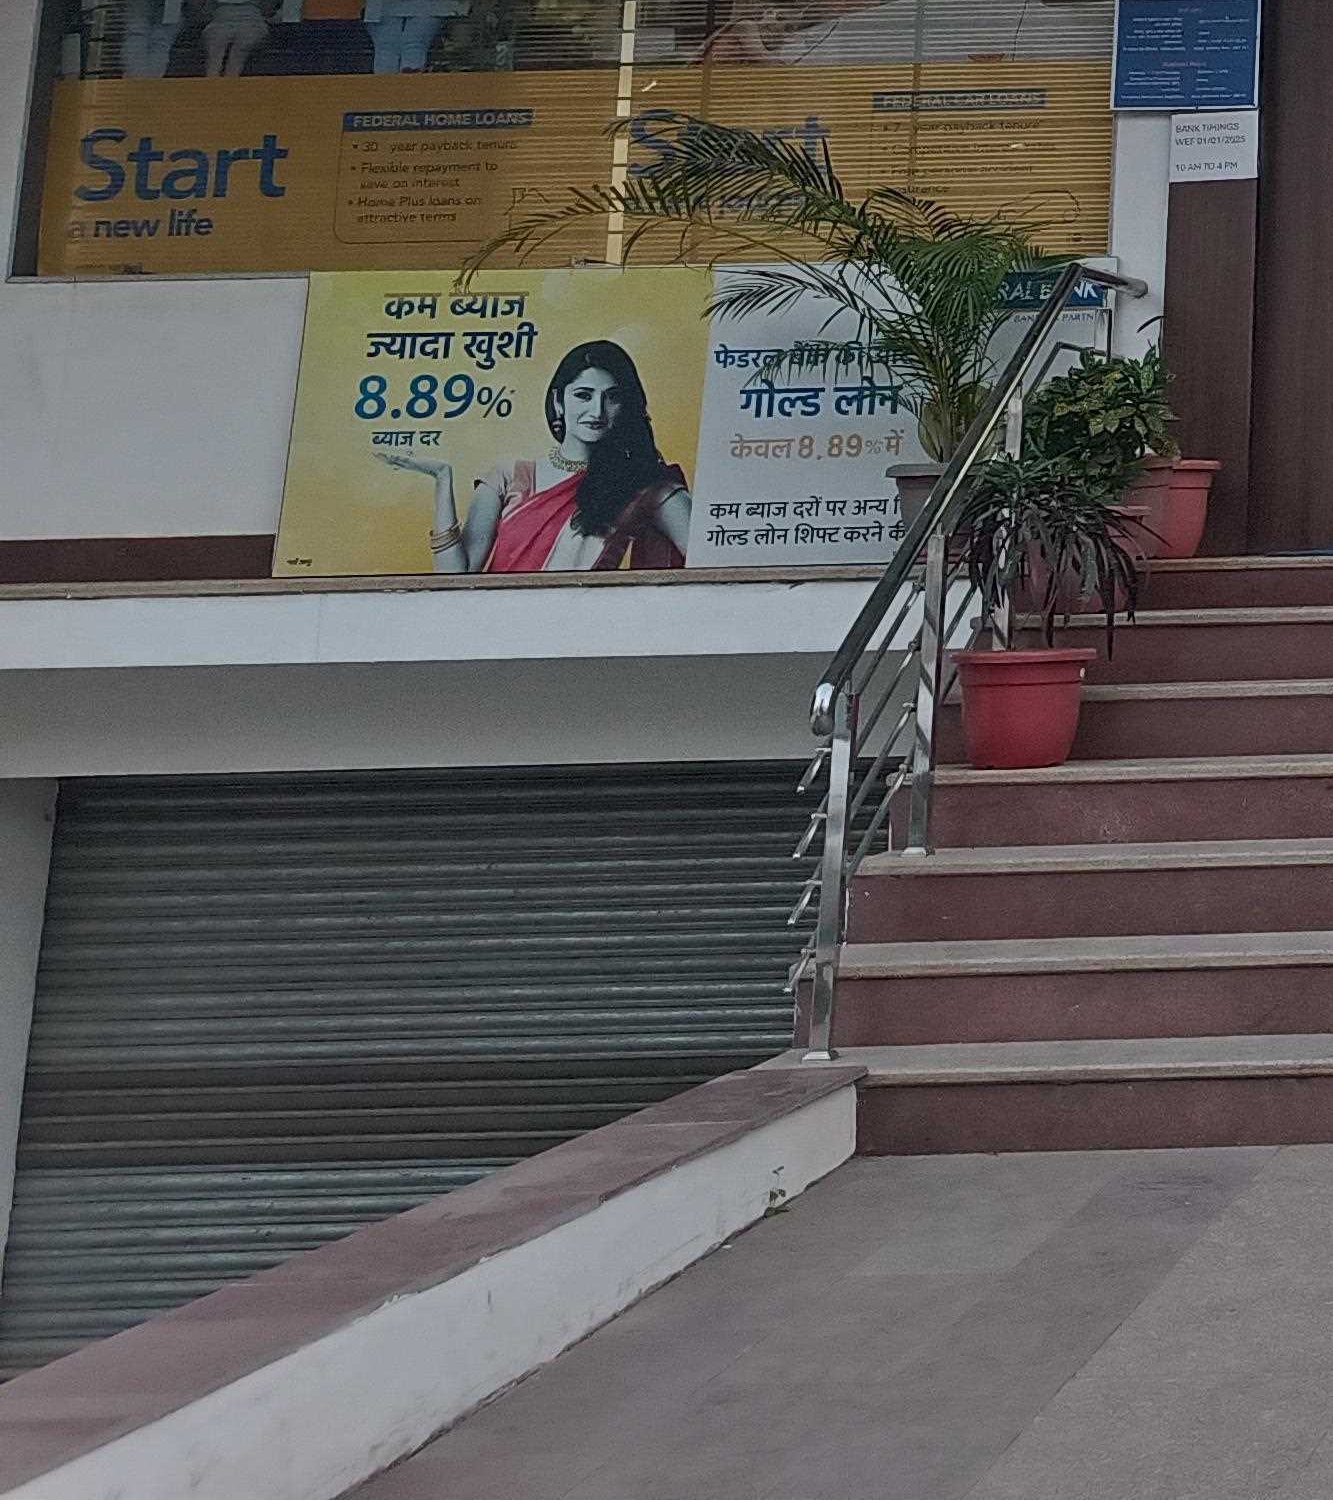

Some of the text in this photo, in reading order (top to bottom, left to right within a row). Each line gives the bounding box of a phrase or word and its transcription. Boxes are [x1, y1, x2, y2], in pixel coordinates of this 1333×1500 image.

[352, 111, 531, 128] FEDERAL HOME LOANS
[1175, 122, 1240, 133] BANK TIMINGS
[74, 127, 290, 201] Start
[485, 162, 498, 171] to
[1203, 162, 1215, 171] TO
[1224, 161, 1239, 170] PM
[93, 218, 161, 238] new
[167, 208, 214, 237] life
[384, 291, 530, 321] कम ब्याज
[367, 321, 538, 370] ज्यादा खुशी
[740, 376, 902, 419] गोल्ड लोन
[371, 430, 442, 447] ब्याज दर
[729, 434, 795, 460] केवल
[709, 502, 741, 519] कम
[745, 501, 788, 518] ब्याज
[793, 495, 823, 518] दरों
[826, 500, 846, 516] पर
[851, 498, 889, 516] अन्य
[706, 520, 884, 547] गोल्ड लोन शिफ्ट करने
